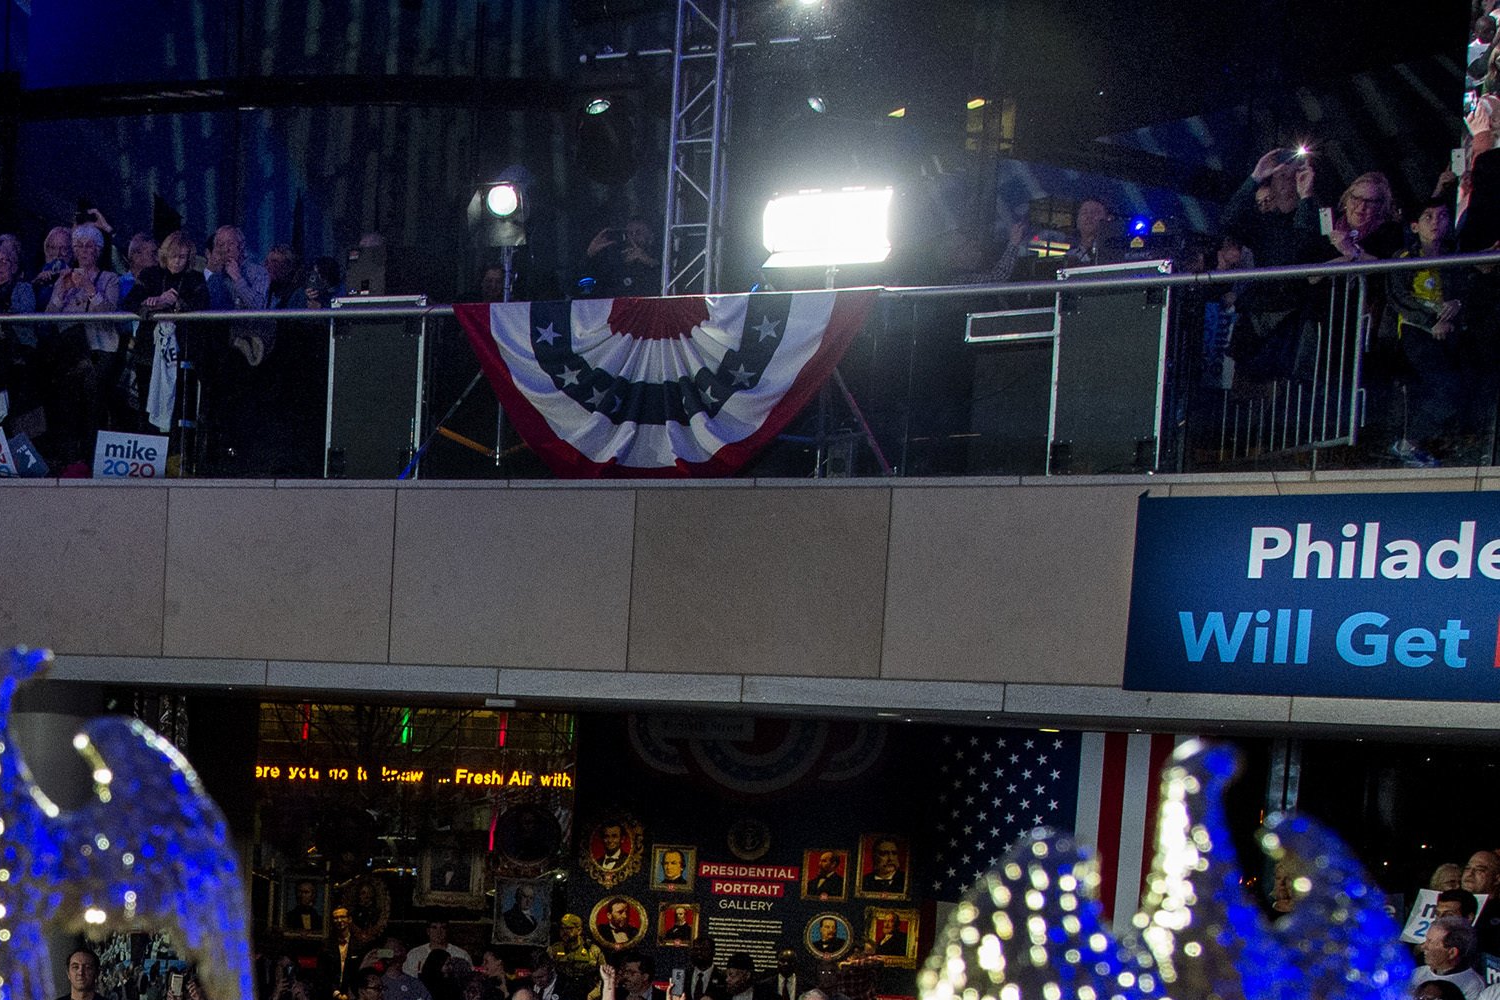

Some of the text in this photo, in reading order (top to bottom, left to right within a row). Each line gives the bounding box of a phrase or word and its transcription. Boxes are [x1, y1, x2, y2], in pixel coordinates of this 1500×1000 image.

[104, 440, 157, 461] mike
[103, 459, 155, 478] 2020
[1178, 608, 1313, 665] Will
[1335, 611, 1471, 669] Get
[455, 768, 504, 786] Fresh
[507, 770, 533, 788] Air
[540, 772, 572, 788] with
[702, 865, 796, 880] PRESIDENTIAL
[715, 882, 781, 896] PORTRAIT
[718, 898, 774, 912] GALLERY
